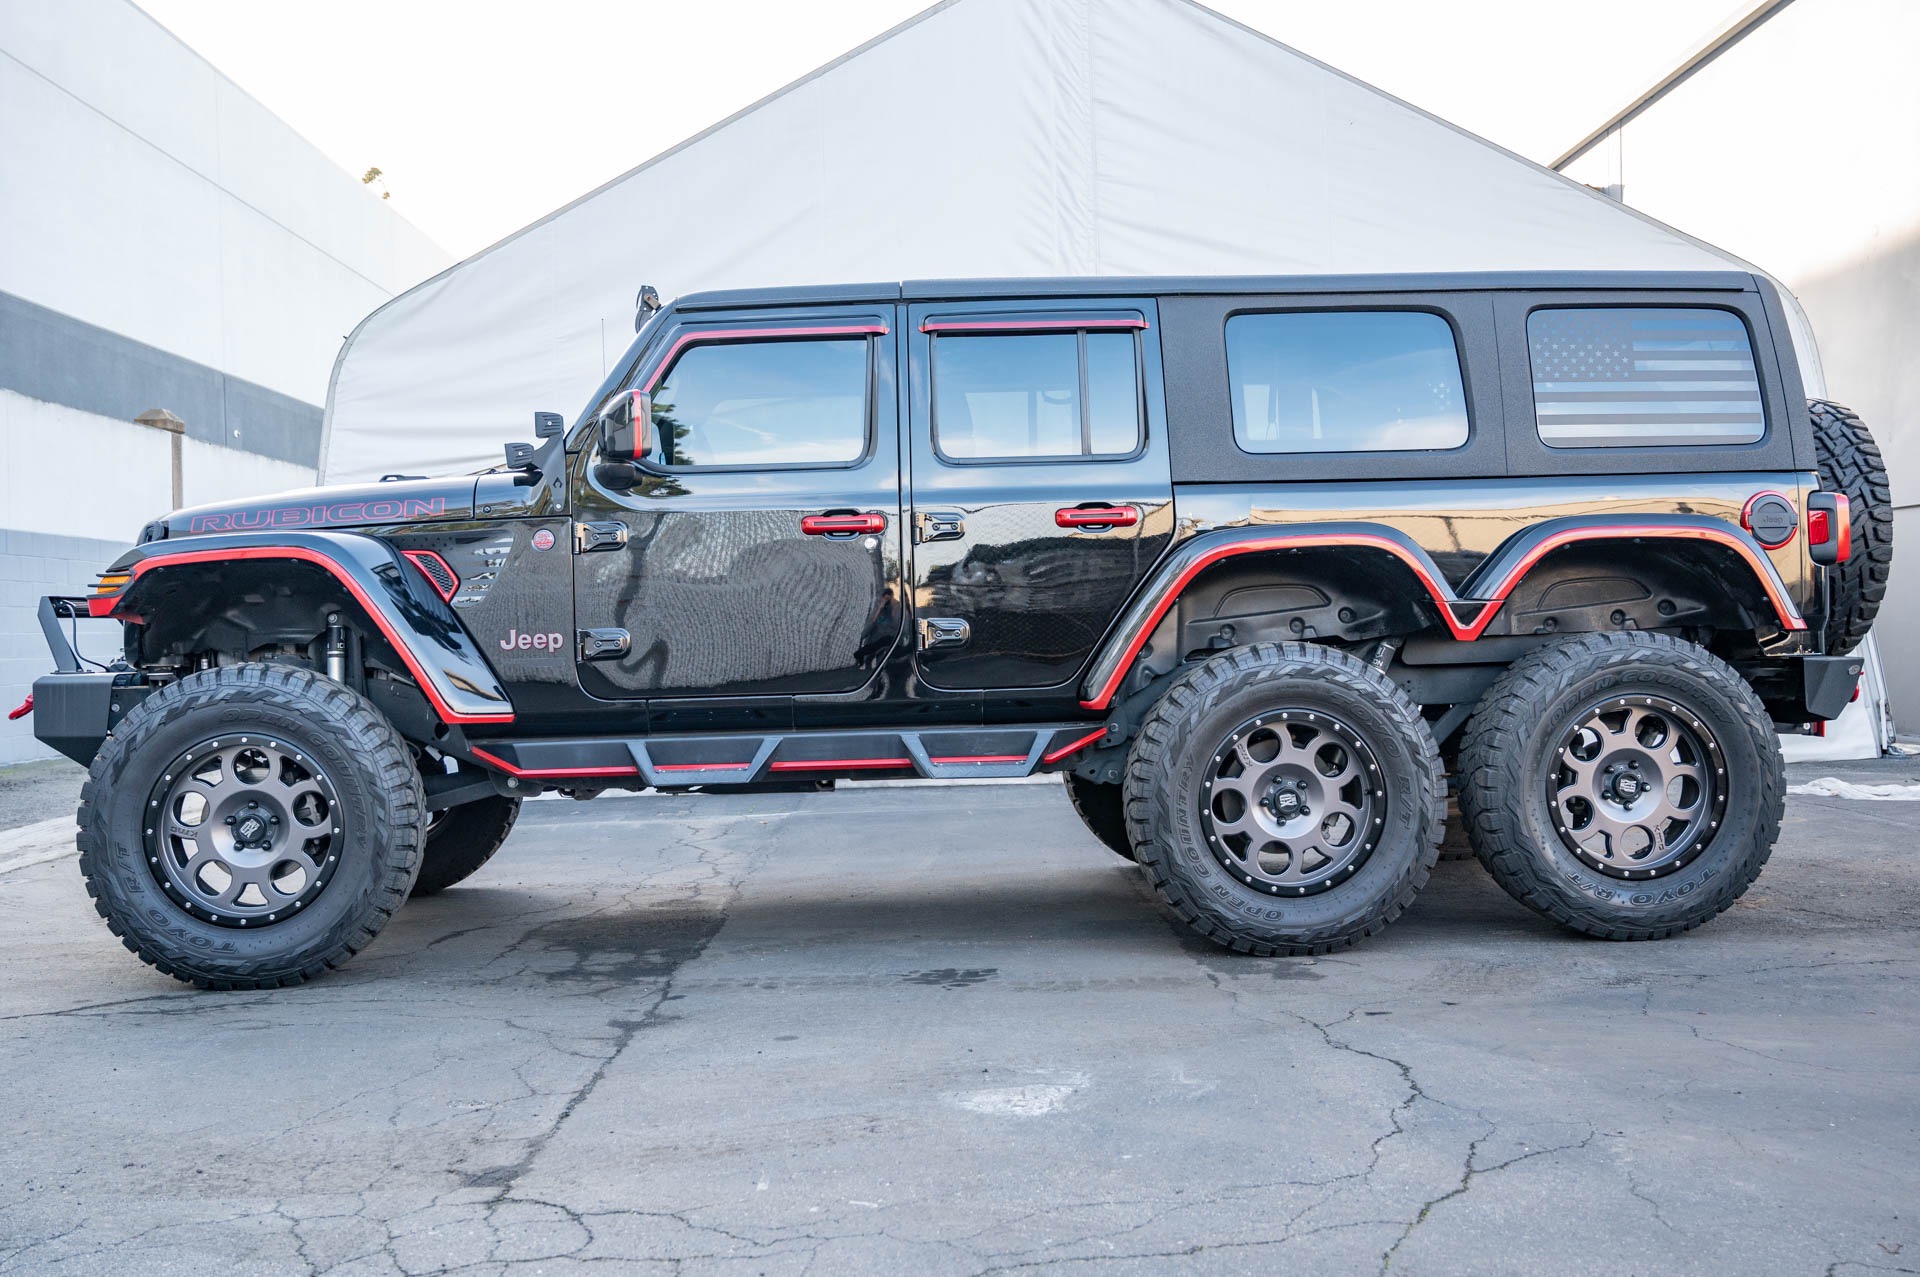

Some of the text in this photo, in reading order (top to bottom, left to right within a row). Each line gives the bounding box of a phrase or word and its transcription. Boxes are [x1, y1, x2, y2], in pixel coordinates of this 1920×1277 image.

[190, 497, 446, 533] RUBICON
[499, 628, 564, 654] Jeep
[1330, 692, 1401, 758] TOYO
[1551, 669, 1736, 727] OPEN COUNTRY
[222, 708, 367, 849] OPEN COUNTRY
[1176, 753, 1284, 921] OPEN COUNTRY
[115, 841, 239, 954] TOYO R/T
[1565, 868, 1720, 905] TOYO R/T
